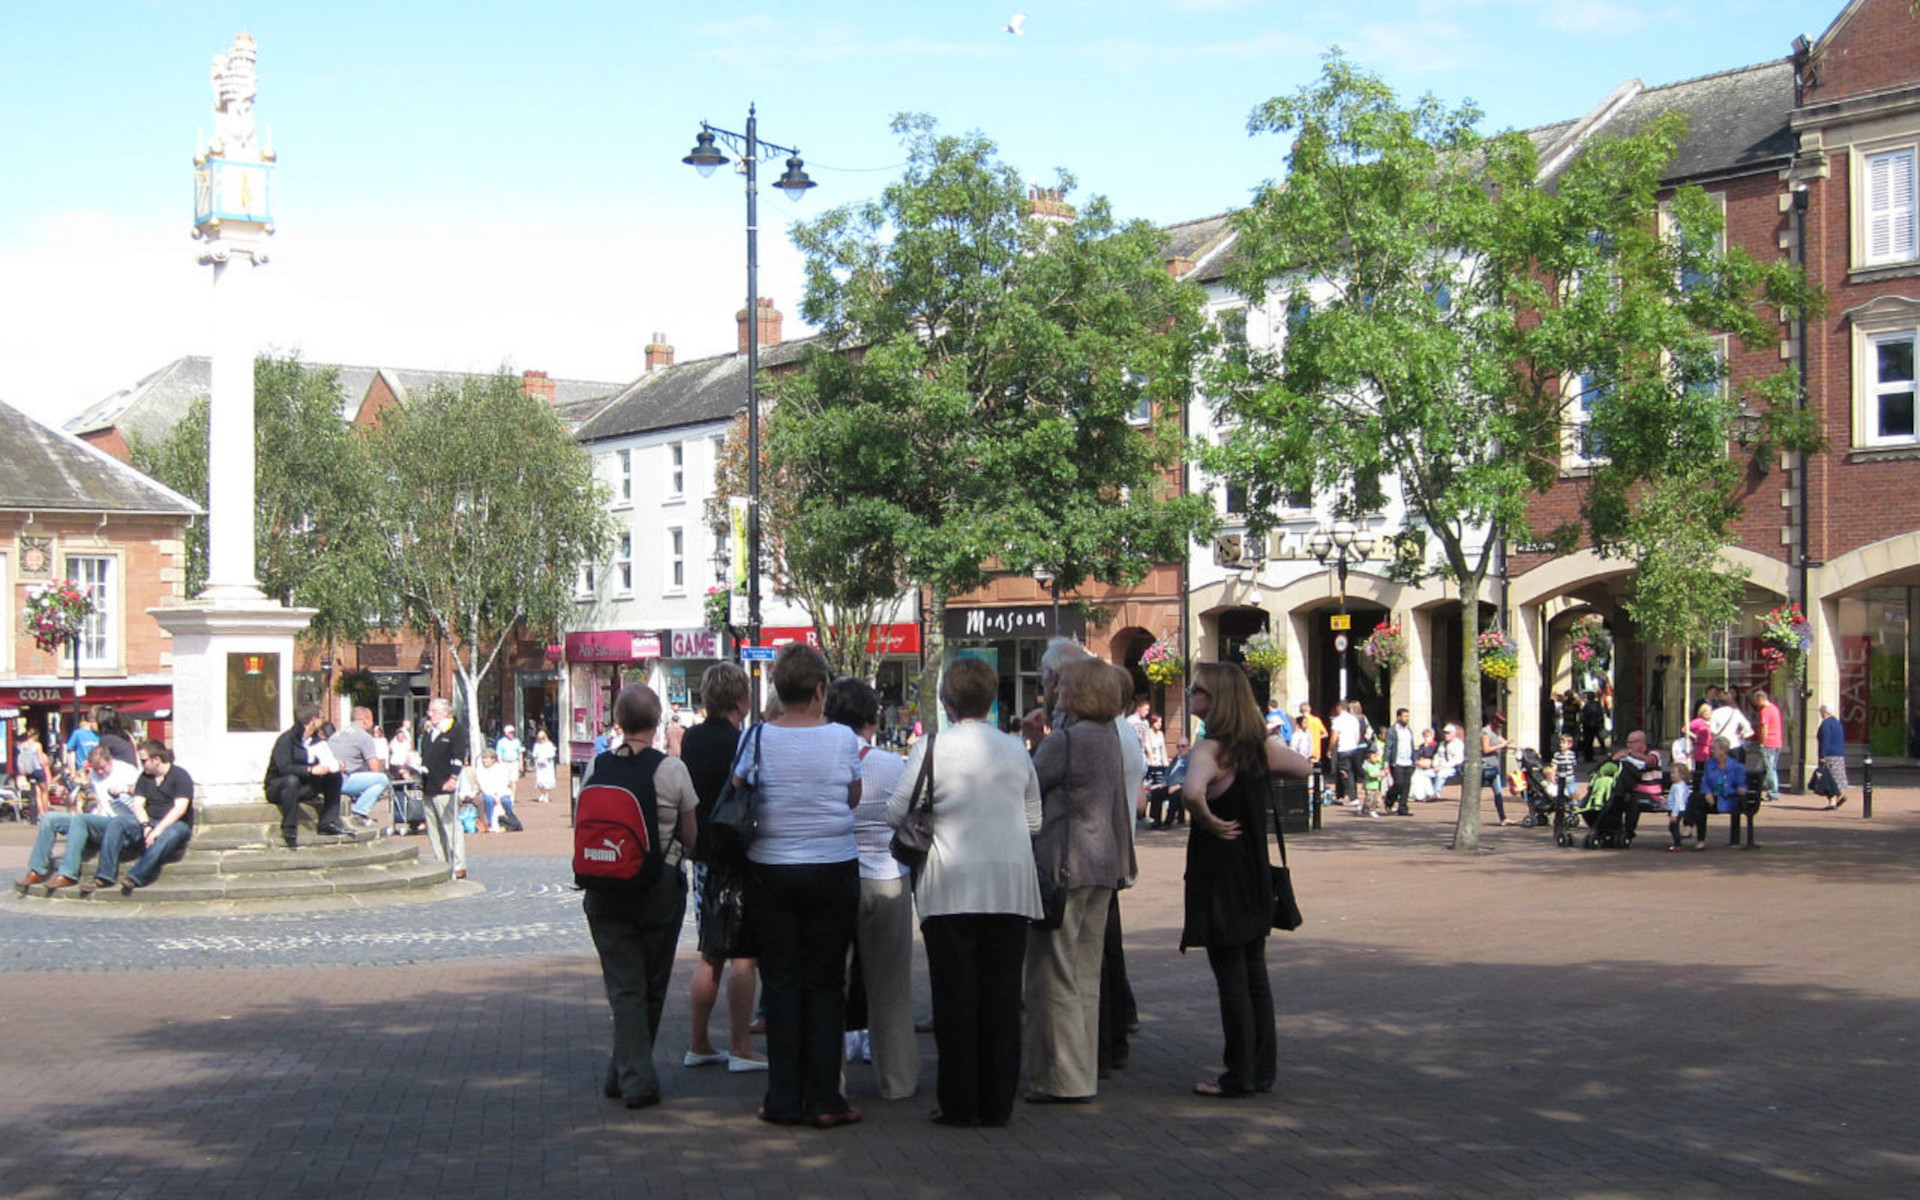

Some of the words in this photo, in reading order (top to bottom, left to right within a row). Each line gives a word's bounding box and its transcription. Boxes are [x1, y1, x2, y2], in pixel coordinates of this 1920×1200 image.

[966, 609, 1046, 636] Monsoon
[673, 632, 717, 656] GAME
[19, 688, 61, 701] COSTA
[1840, 647, 1867, 722] SALE
[584, 847, 616, 863] PUMA
